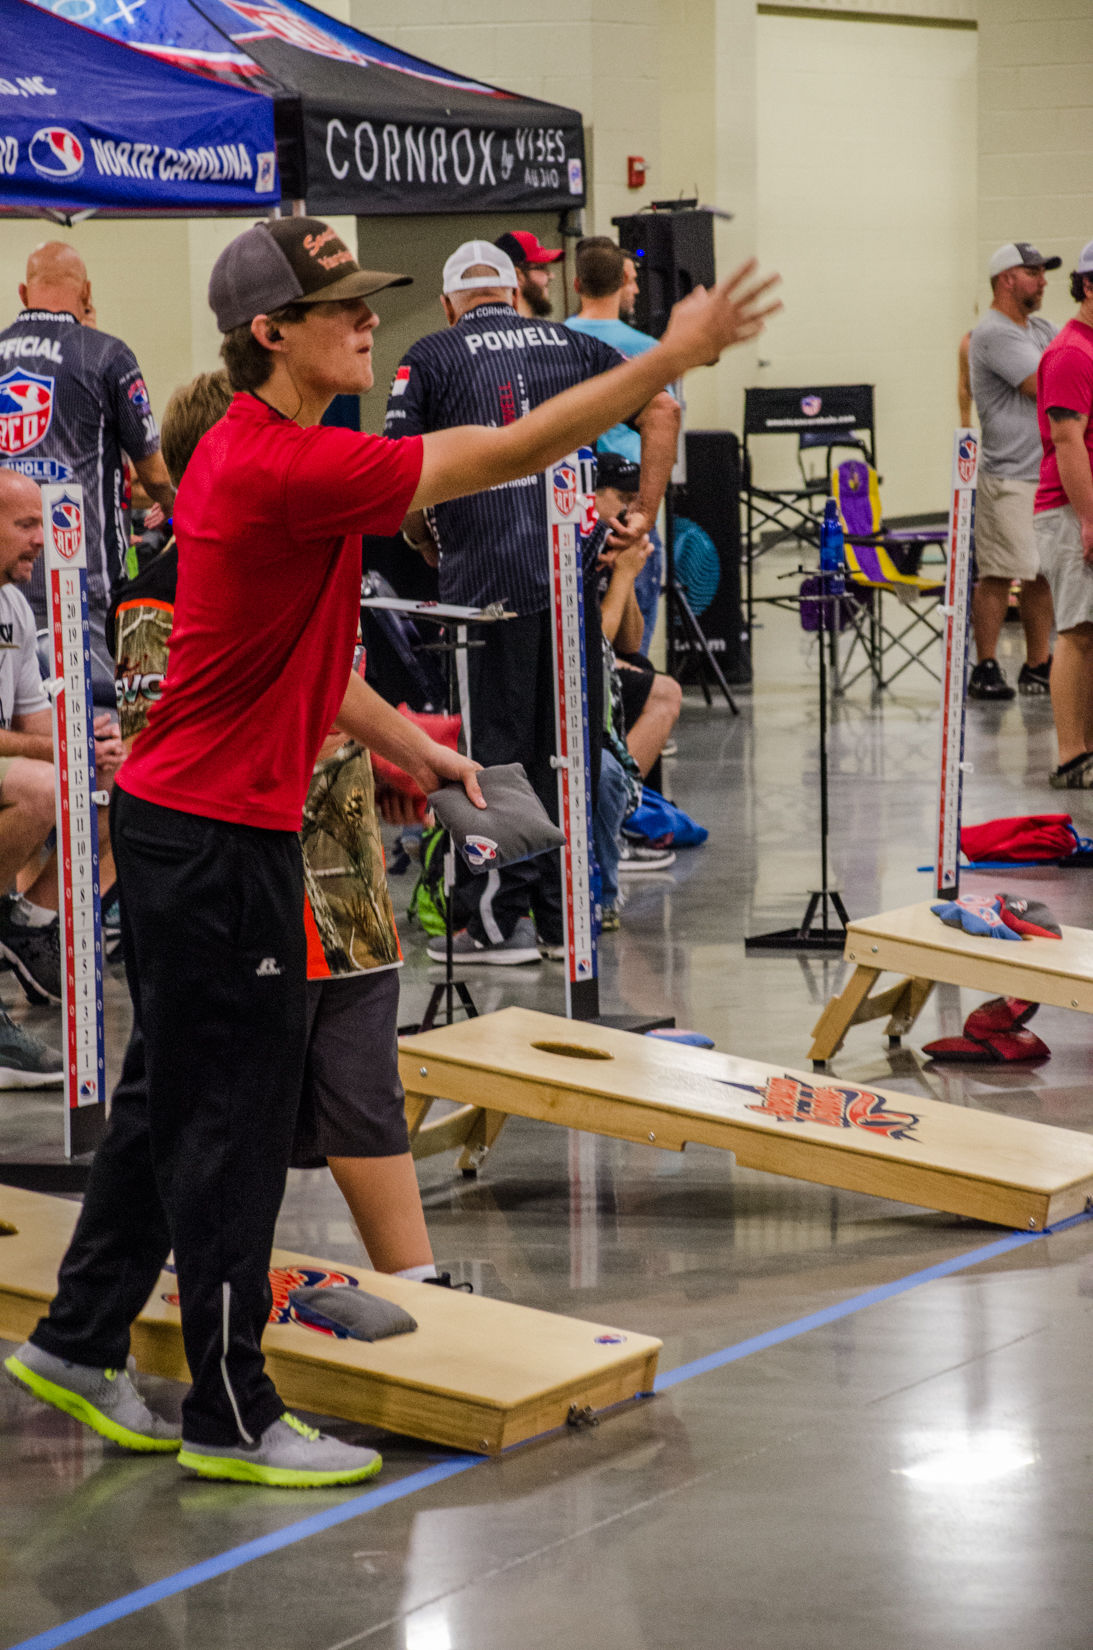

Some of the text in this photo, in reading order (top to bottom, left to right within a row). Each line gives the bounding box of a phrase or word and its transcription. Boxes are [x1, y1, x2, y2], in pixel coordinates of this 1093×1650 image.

[90, 138, 159, 180] NORTH
[159, 143, 253, 181] CAROLINA
[326, 118, 497, 186] CORNROX
[464, 327, 568, 354] POWELL
[66, 579, 74, 595] 21
[67, 604, 76, 619] 20
[68, 628, 77, 643] 19
[69, 652, 78, 667] 18
[71, 675, 79, 690] 17
[72, 699, 80, 714] 16
[73, 722, 81, 738] 15
[74, 746, 82, 761] 14
[75, 770, 83, 785] 13
[76, 793, 83, 808] 12
[77, 817, 84, 833] 11
[77, 841, 86, 856] 10
